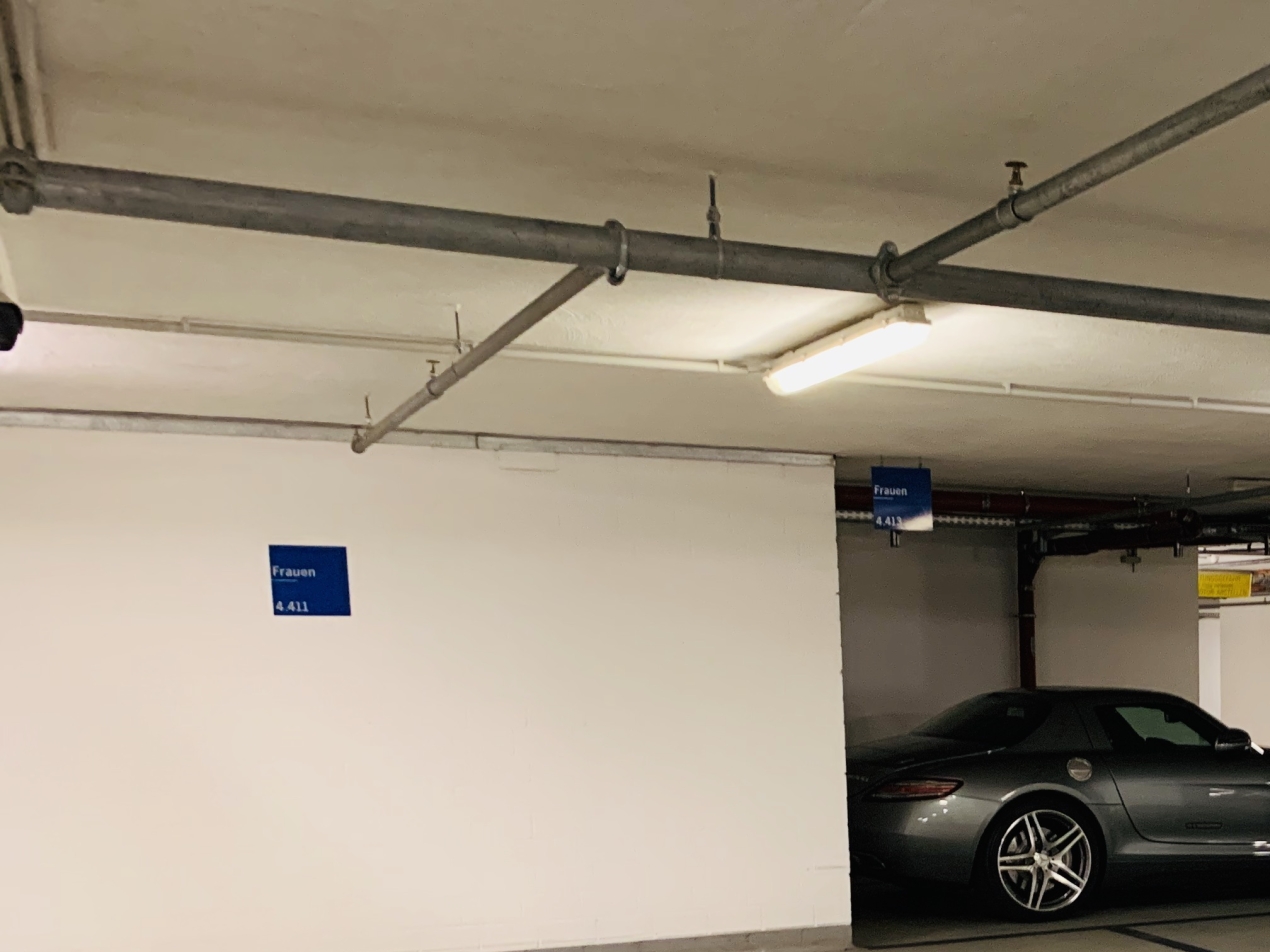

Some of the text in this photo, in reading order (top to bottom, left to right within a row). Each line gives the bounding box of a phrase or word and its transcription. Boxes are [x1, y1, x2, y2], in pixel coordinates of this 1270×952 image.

[874, 484, 908, 497] Frauen
[875, 516, 903, 527] 4.413
[272, 565, 316, 578] Frauen
[275, 600, 309, 613] 4.411
